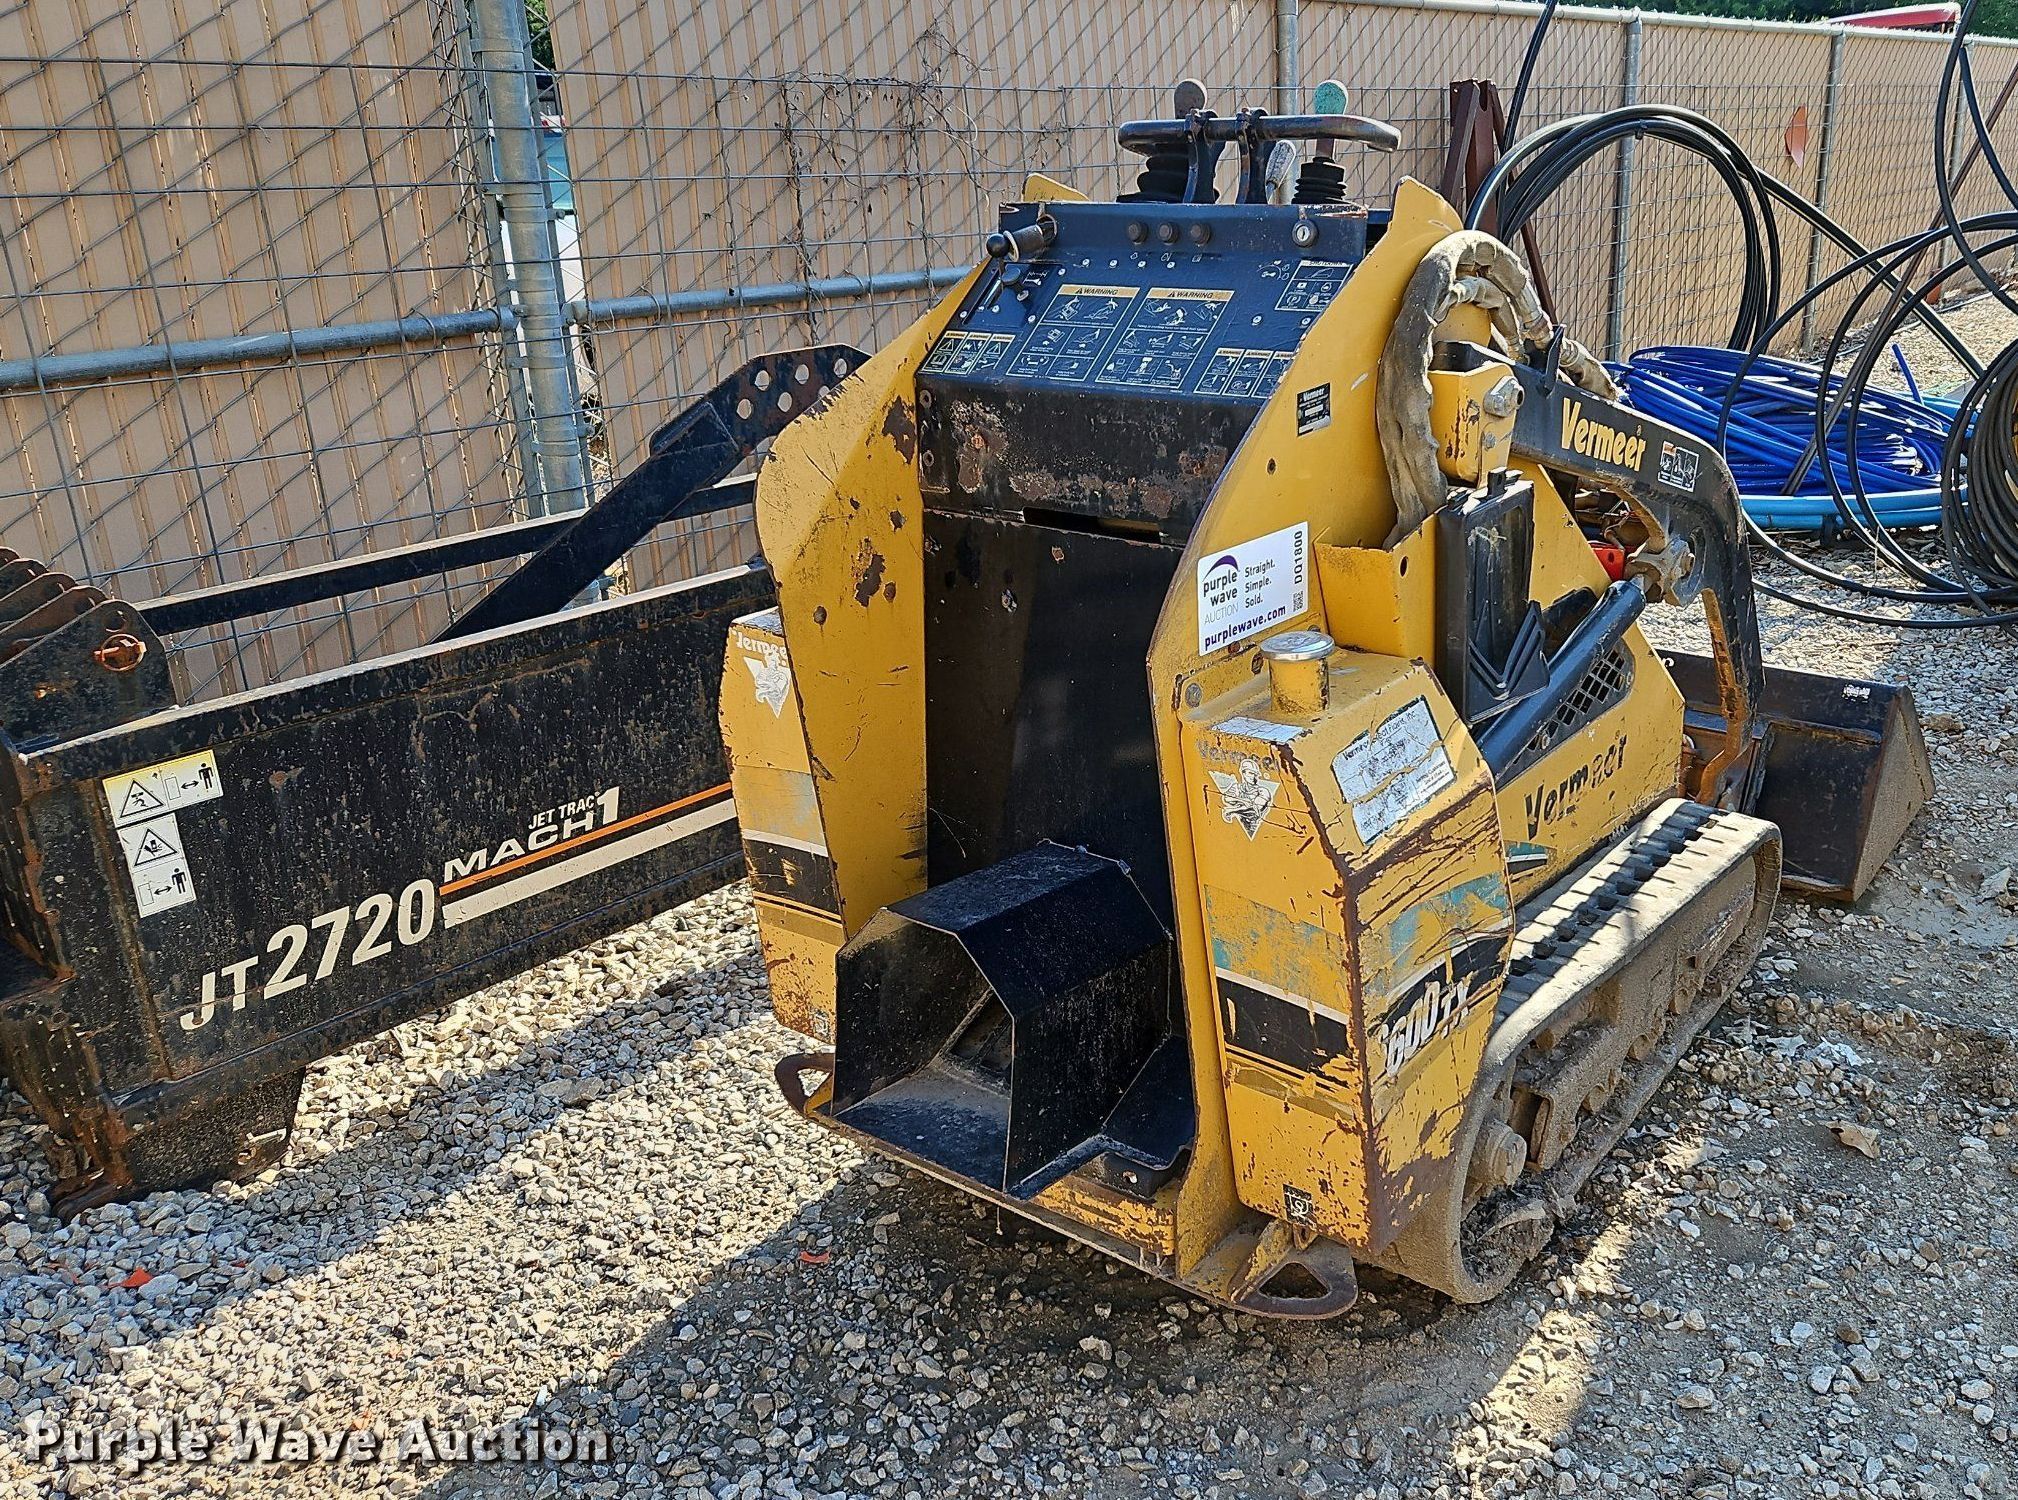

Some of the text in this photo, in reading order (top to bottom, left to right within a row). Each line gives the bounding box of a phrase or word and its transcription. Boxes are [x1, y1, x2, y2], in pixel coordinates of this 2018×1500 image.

[1083, 287, 1119, 296] WARNING
[1175, 291, 1214, 299] WARNING
[1561, 397, 1647, 472] Vermeer
[1293, 530, 1303, 585] DQ1800
[1244, 558, 1276, 578] Straight.
[1203, 569, 1238, 598] purple
[1244, 577, 1272, 594] Simple.
[1210, 587, 1238, 607] wave
[1244, 593, 1264, 609] Sold.
[1203, 602, 1239, 626] AUCTION
[1204, 605, 1286, 652] purplewave.com
[528, 809, 556, 830] JET
